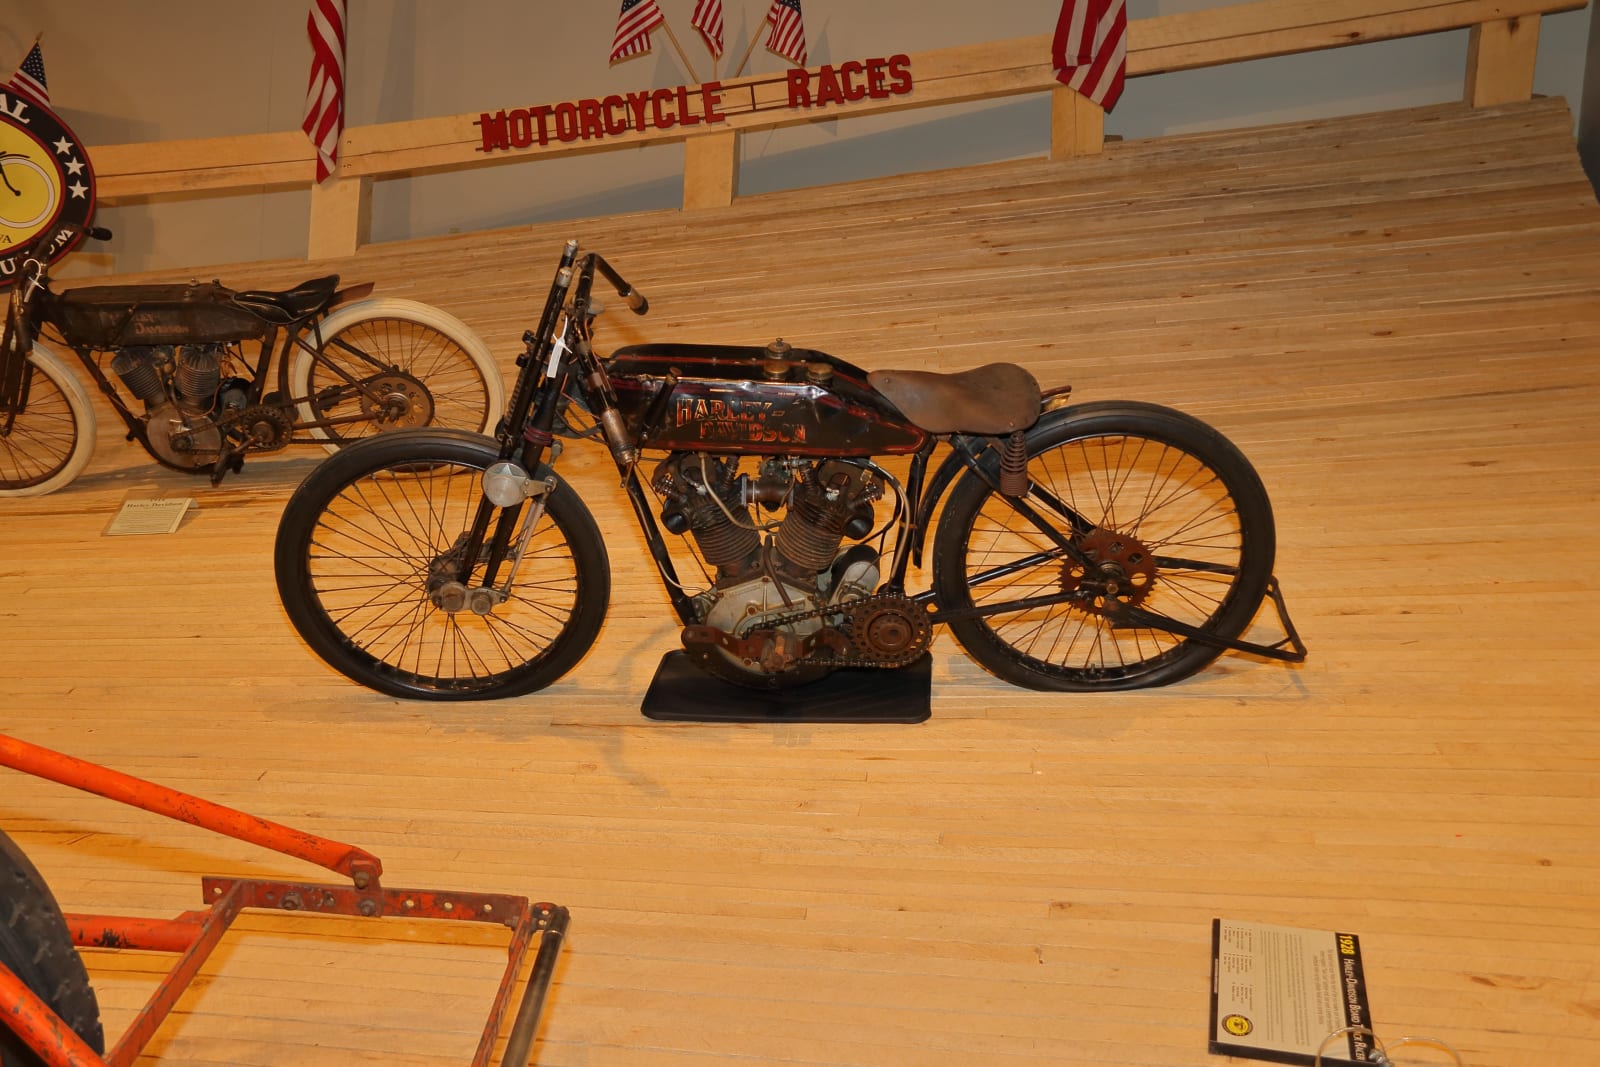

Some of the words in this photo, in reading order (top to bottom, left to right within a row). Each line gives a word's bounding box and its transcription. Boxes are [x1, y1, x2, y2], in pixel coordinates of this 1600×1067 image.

[481, 81, 725, 152] MOTORCYCLE
[787, 54, 913, 108] RACES
[1339, 935, 1355, 956] 1928
